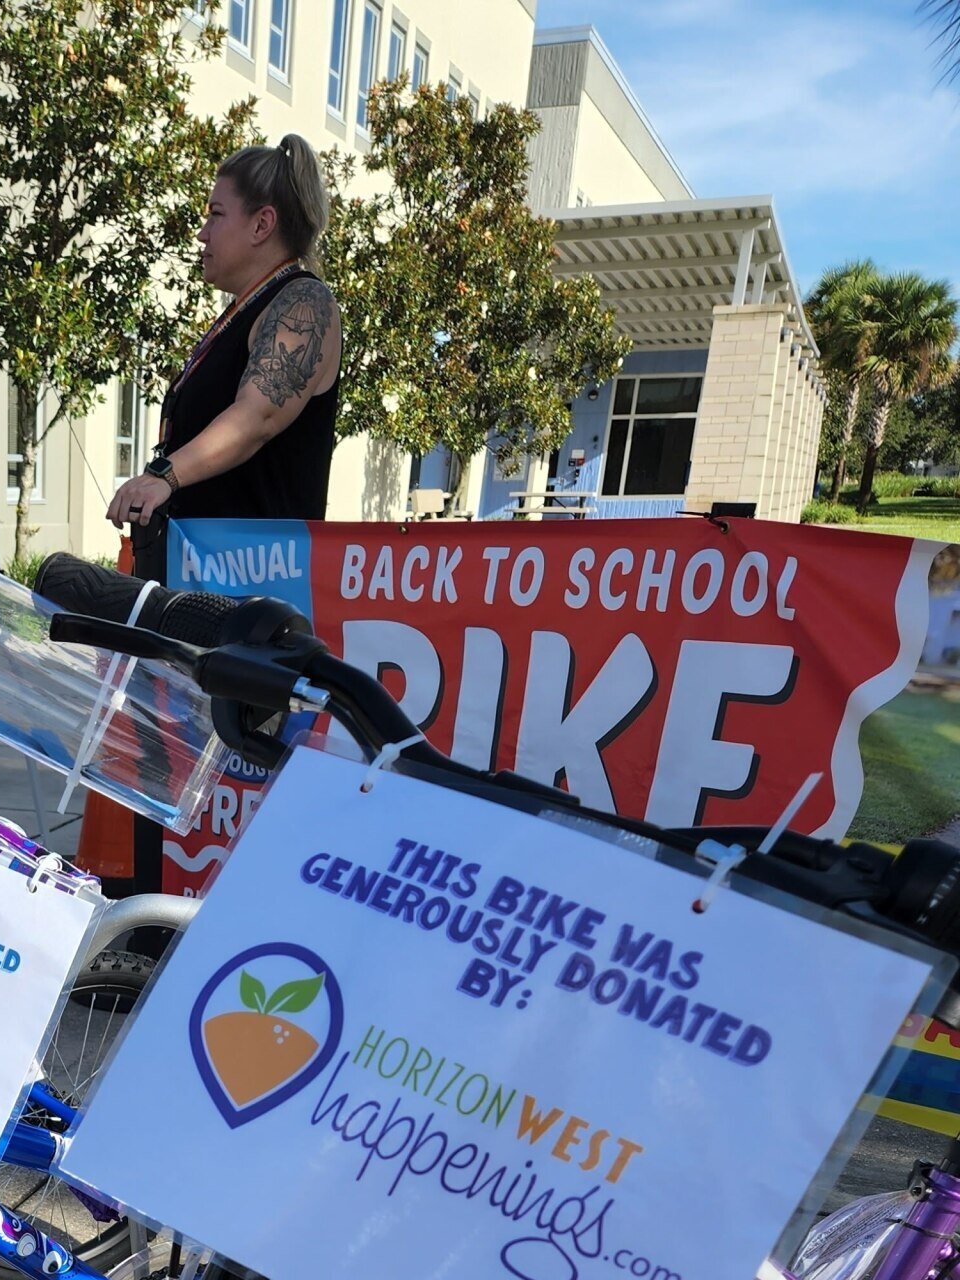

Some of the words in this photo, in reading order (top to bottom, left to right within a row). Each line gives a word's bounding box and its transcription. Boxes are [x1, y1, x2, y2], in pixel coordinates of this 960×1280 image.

[181, 538, 303, 587] ANNUAL
[339, 544, 463, 601] BACK
[482, 546, 546, 602] TO
[563, 547, 799, 621] SCHOOL
[387, 837, 481, 902] THIS
[489, 875, 605, 951] BIKE
[612, 921, 706, 990] WAS
[299, 851, 558, 983] GENEROUSLY
[560, 958, 774, 1069] DONATED
[455, 956, 531, 1018] BY:
